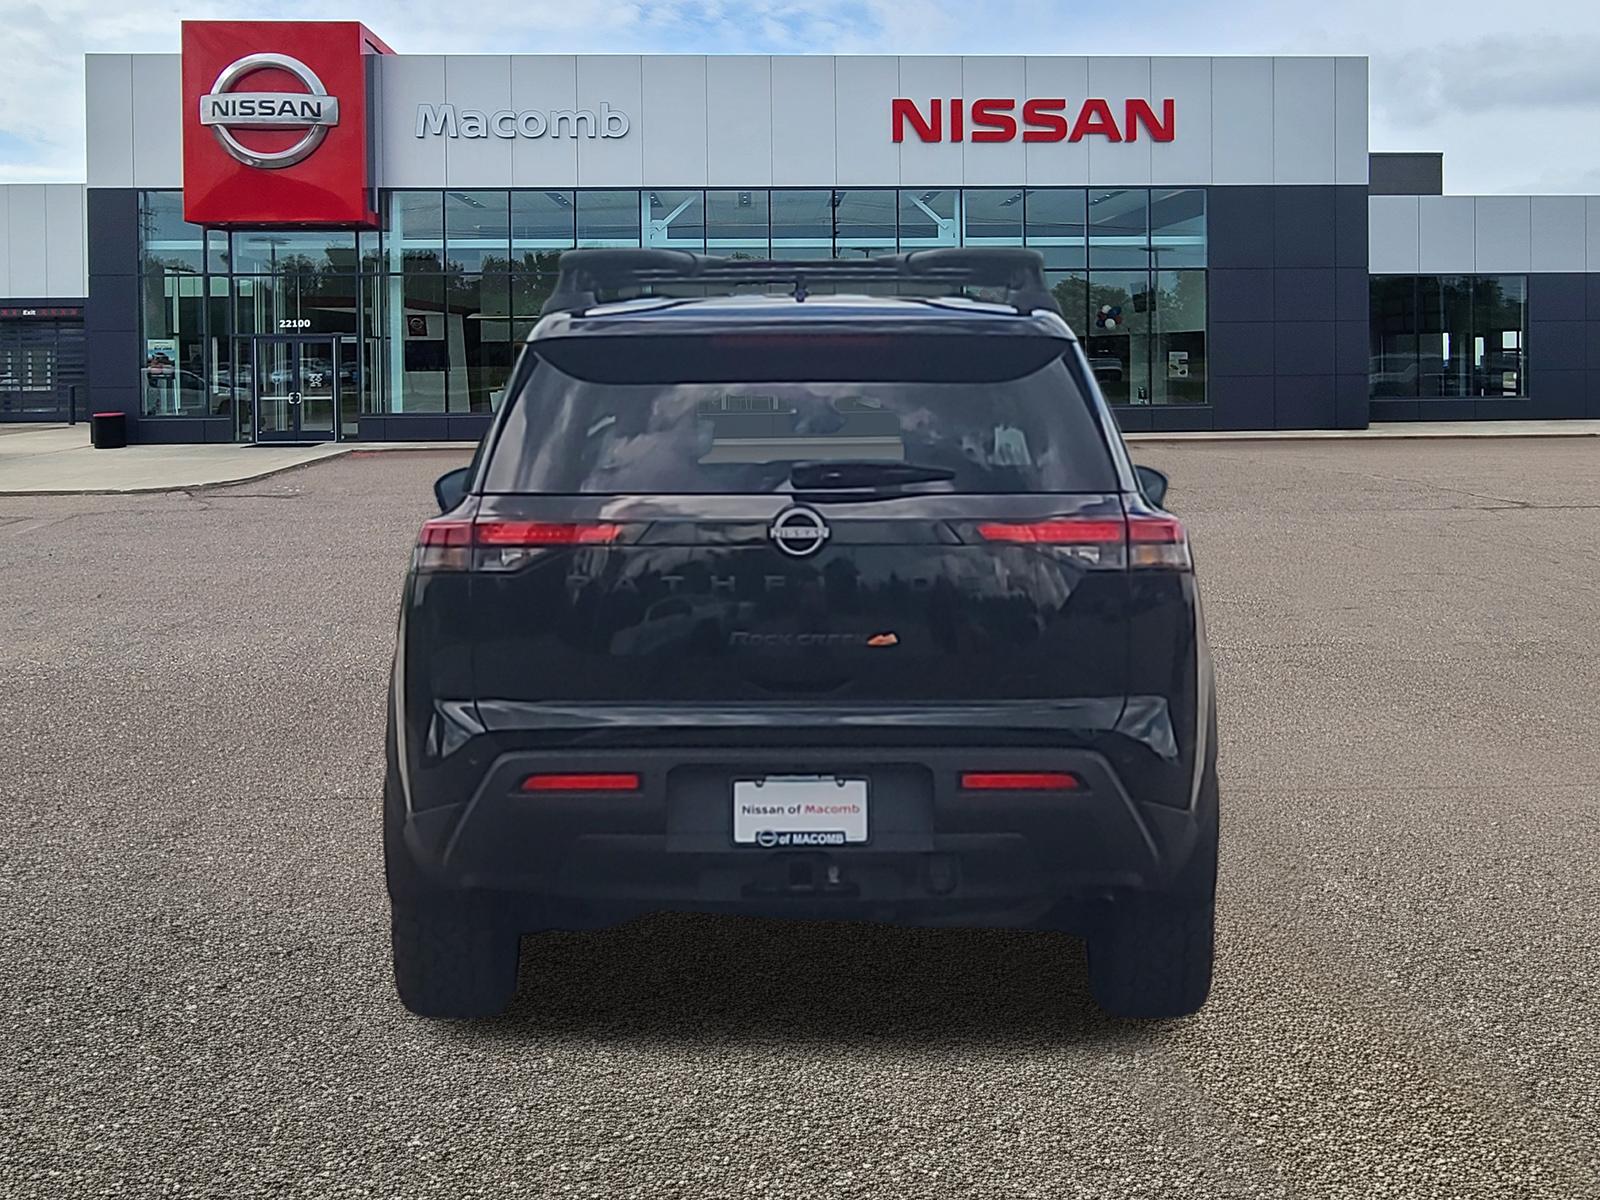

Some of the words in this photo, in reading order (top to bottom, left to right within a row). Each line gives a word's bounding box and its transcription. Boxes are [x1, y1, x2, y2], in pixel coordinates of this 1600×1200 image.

[211, 100, 322, 118] NISSAN
[415, 102, 630, 138] Macomb
[892, 98, 1175, 143] NISSAN
[279, 319, 311, 328] 22100
[741, 804, 785, 815] Nissan
[787, 803, 802, 815] of
[804, 803, 860, 815] Macomb
[779, 833, 791, 845] of
[792, 833, 845, 845] MACOMB
